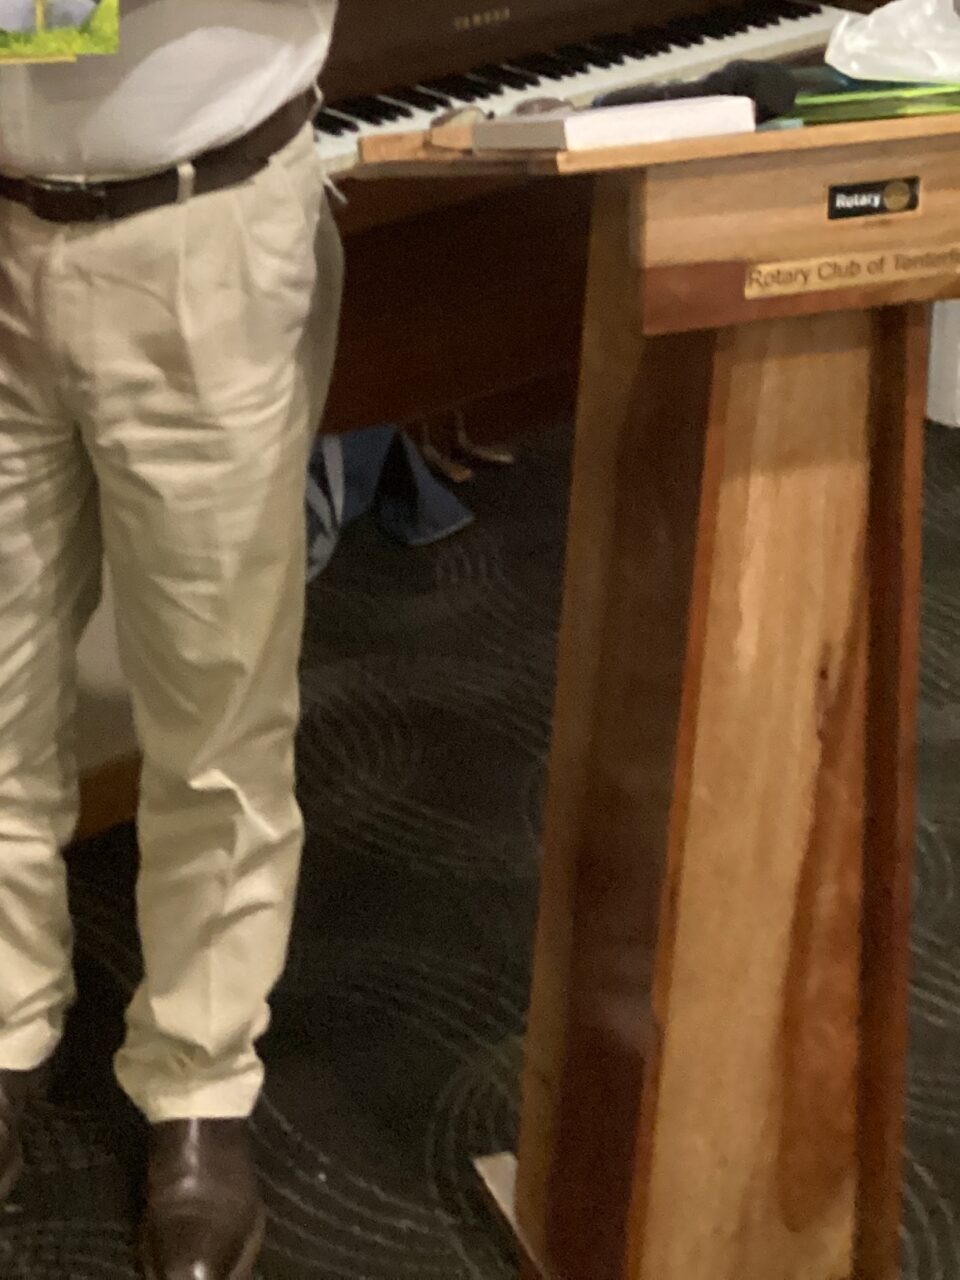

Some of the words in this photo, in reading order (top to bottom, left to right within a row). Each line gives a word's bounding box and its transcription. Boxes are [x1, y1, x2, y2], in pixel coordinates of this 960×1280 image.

[835, 192, 881, 209] Rotary
[749, 267, 810, 288] Rotary
[818, 260, 861, 280] Club
[867, 256, 886, 275] of
